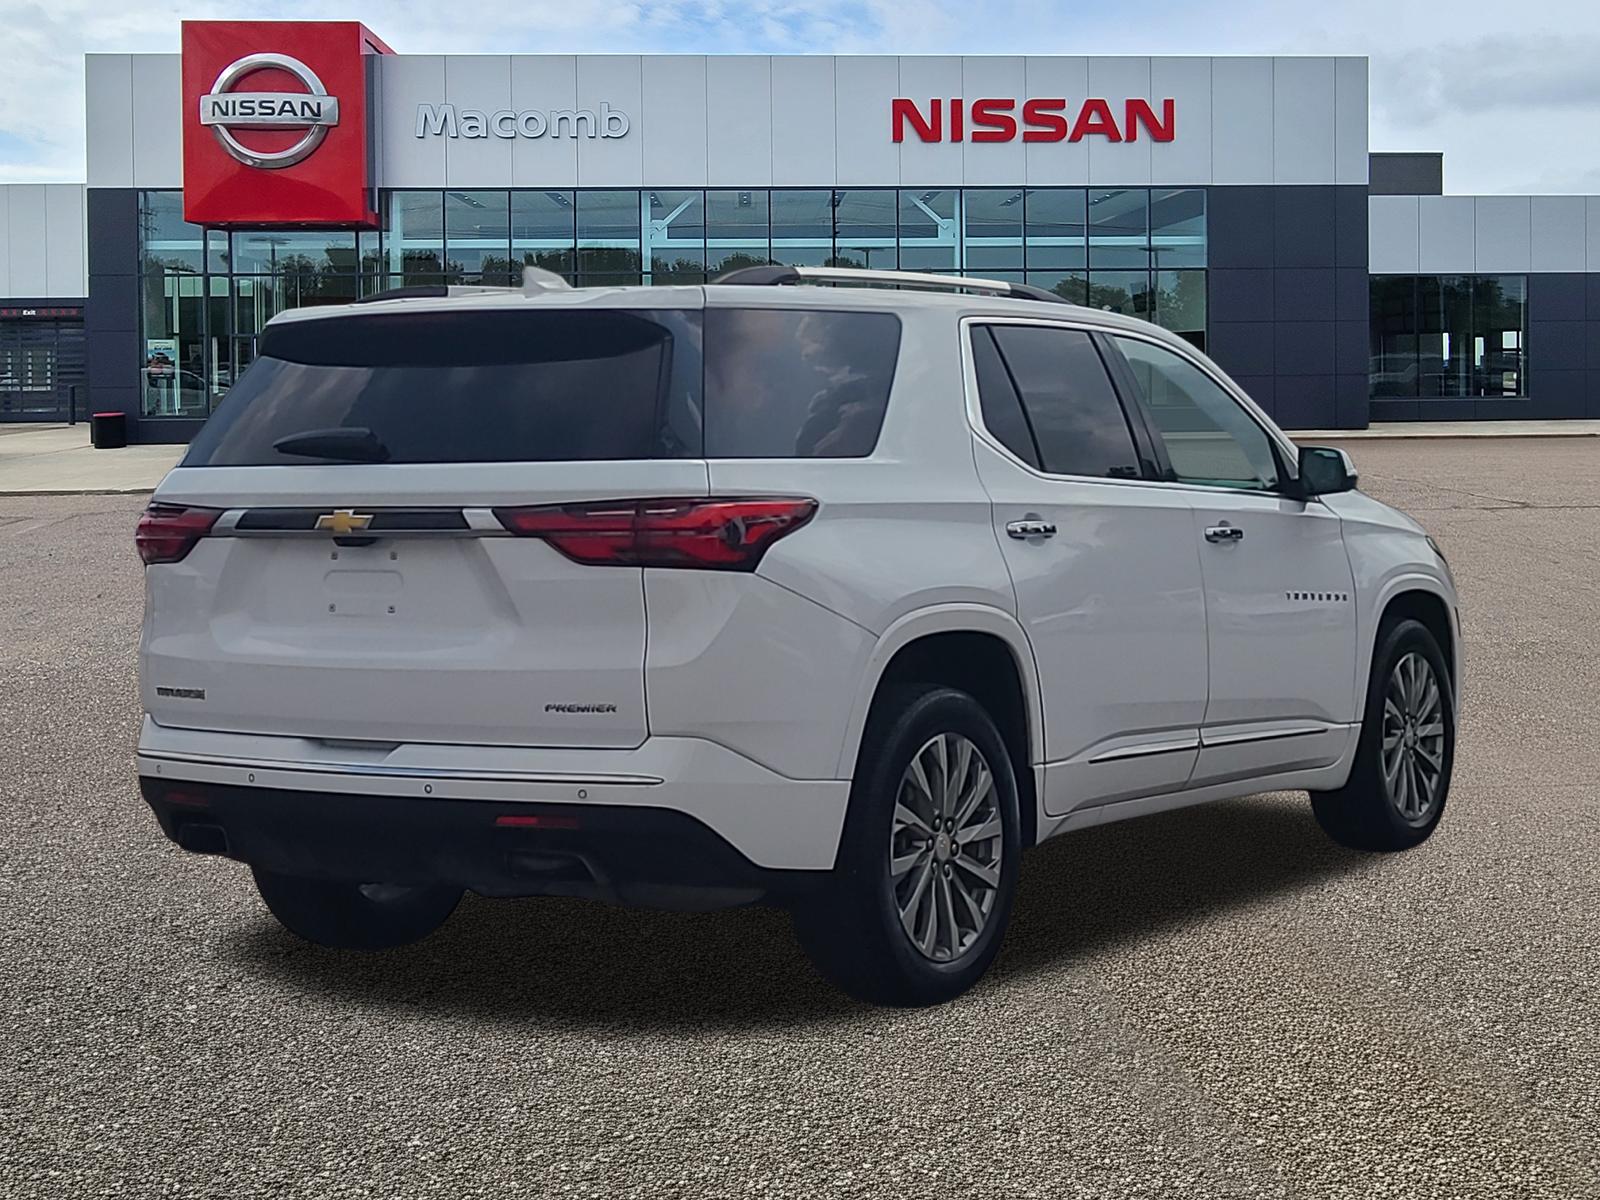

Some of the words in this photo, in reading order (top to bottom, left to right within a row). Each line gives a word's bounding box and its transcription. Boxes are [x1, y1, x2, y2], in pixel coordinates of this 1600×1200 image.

[211, 100, 322, 118] NISSAN
[415, 101, 630, 139] Macomb
[891, 98, 1175, 143] NISSAN
[544, 703, 617, 713] PREMIER
